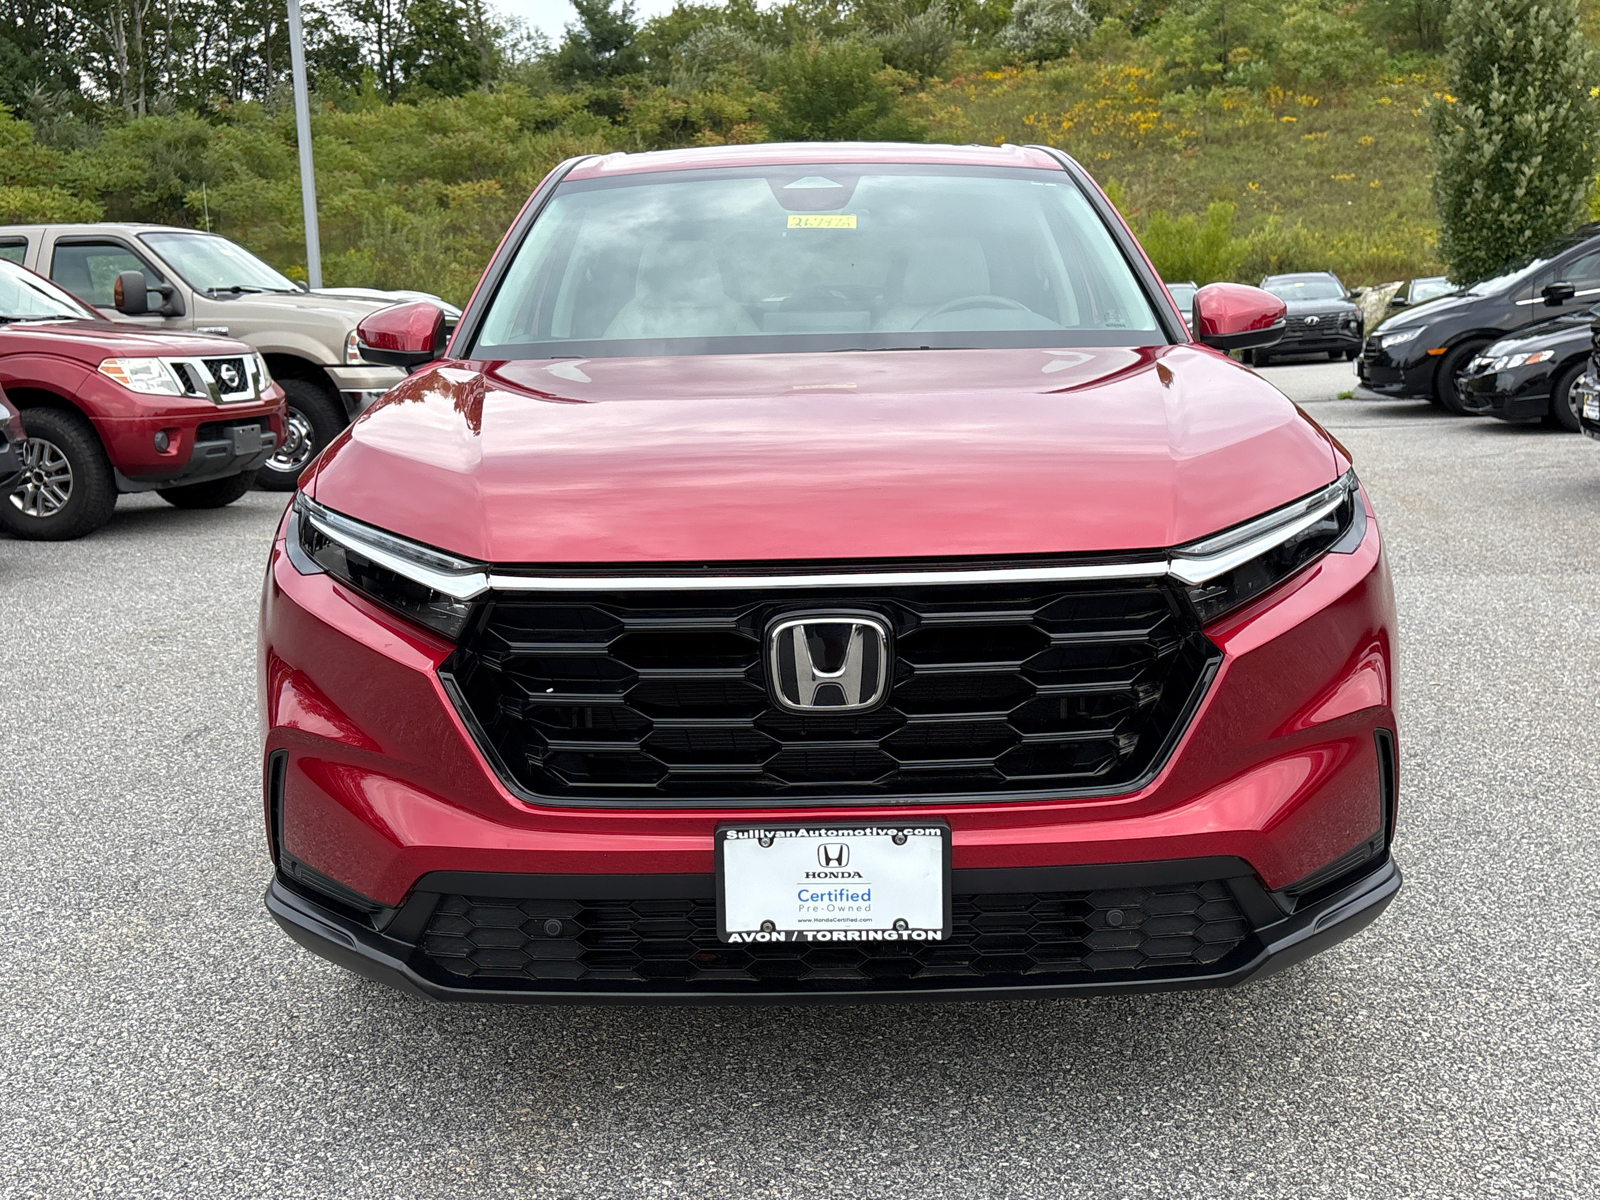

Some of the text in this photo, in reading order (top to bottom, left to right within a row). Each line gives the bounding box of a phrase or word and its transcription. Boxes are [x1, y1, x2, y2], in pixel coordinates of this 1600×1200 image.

[726, 828, 941, 840] SullivanAutomotive.com
[805, 871, 863, 879] HONDA
[798, 888, 871, 902] Certified
[798, 904, 871, 912] Pre-Owned
[728, 931, 785, 943] AVON
[803, 930, 942, 941] TORRINGTON
